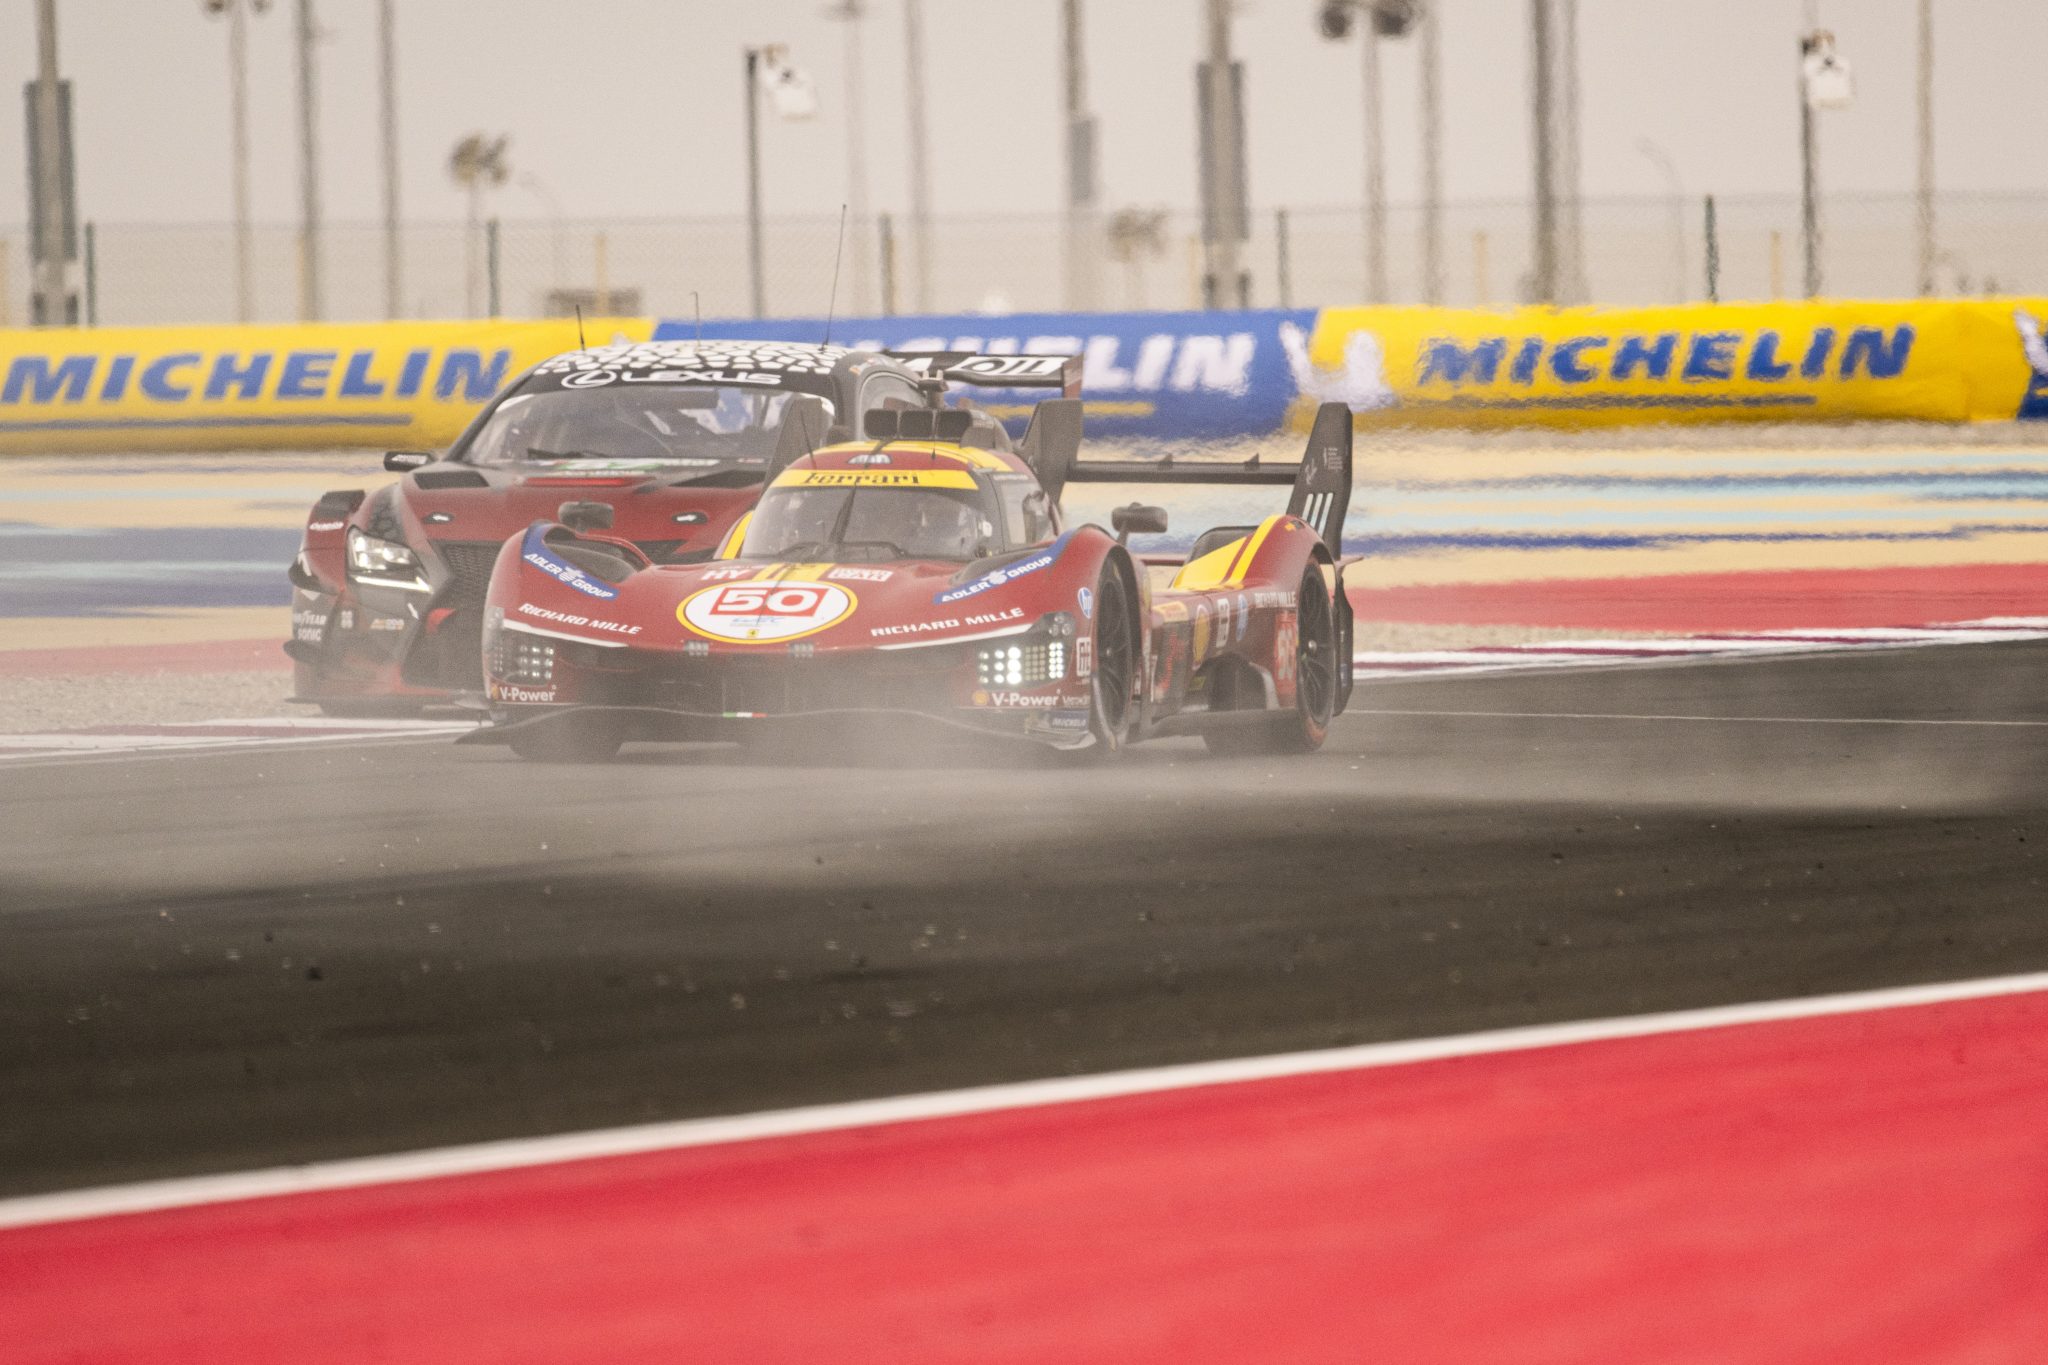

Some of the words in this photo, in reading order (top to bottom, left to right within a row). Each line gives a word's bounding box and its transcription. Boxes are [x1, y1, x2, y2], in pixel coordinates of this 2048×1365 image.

[1417, 325, 1915, 386] MICHELIN
[3, 349, 511, 403] MICHELIN
[621, 370, 782, 385] LEXUS
[804, 471, 920, 484] Ferrari
[523, 553, 562, 575] ADLER
[572, 578, 614, 598] GROUP
[941, 581, 991, 603] ADLER
[1007, 556, 1053, 578] GROUP
[717, 588, 819, 614] 50
[518, 603, 589, 626] RICHARD
[588, 620, 643, 635] MILLE
[870, 618, 960, 637] RICHARD
[965, 607, 1025, 626] MILLE
[499, 686, 556, 702] V-Power
[991, 692, 1060, 707] V-Power
